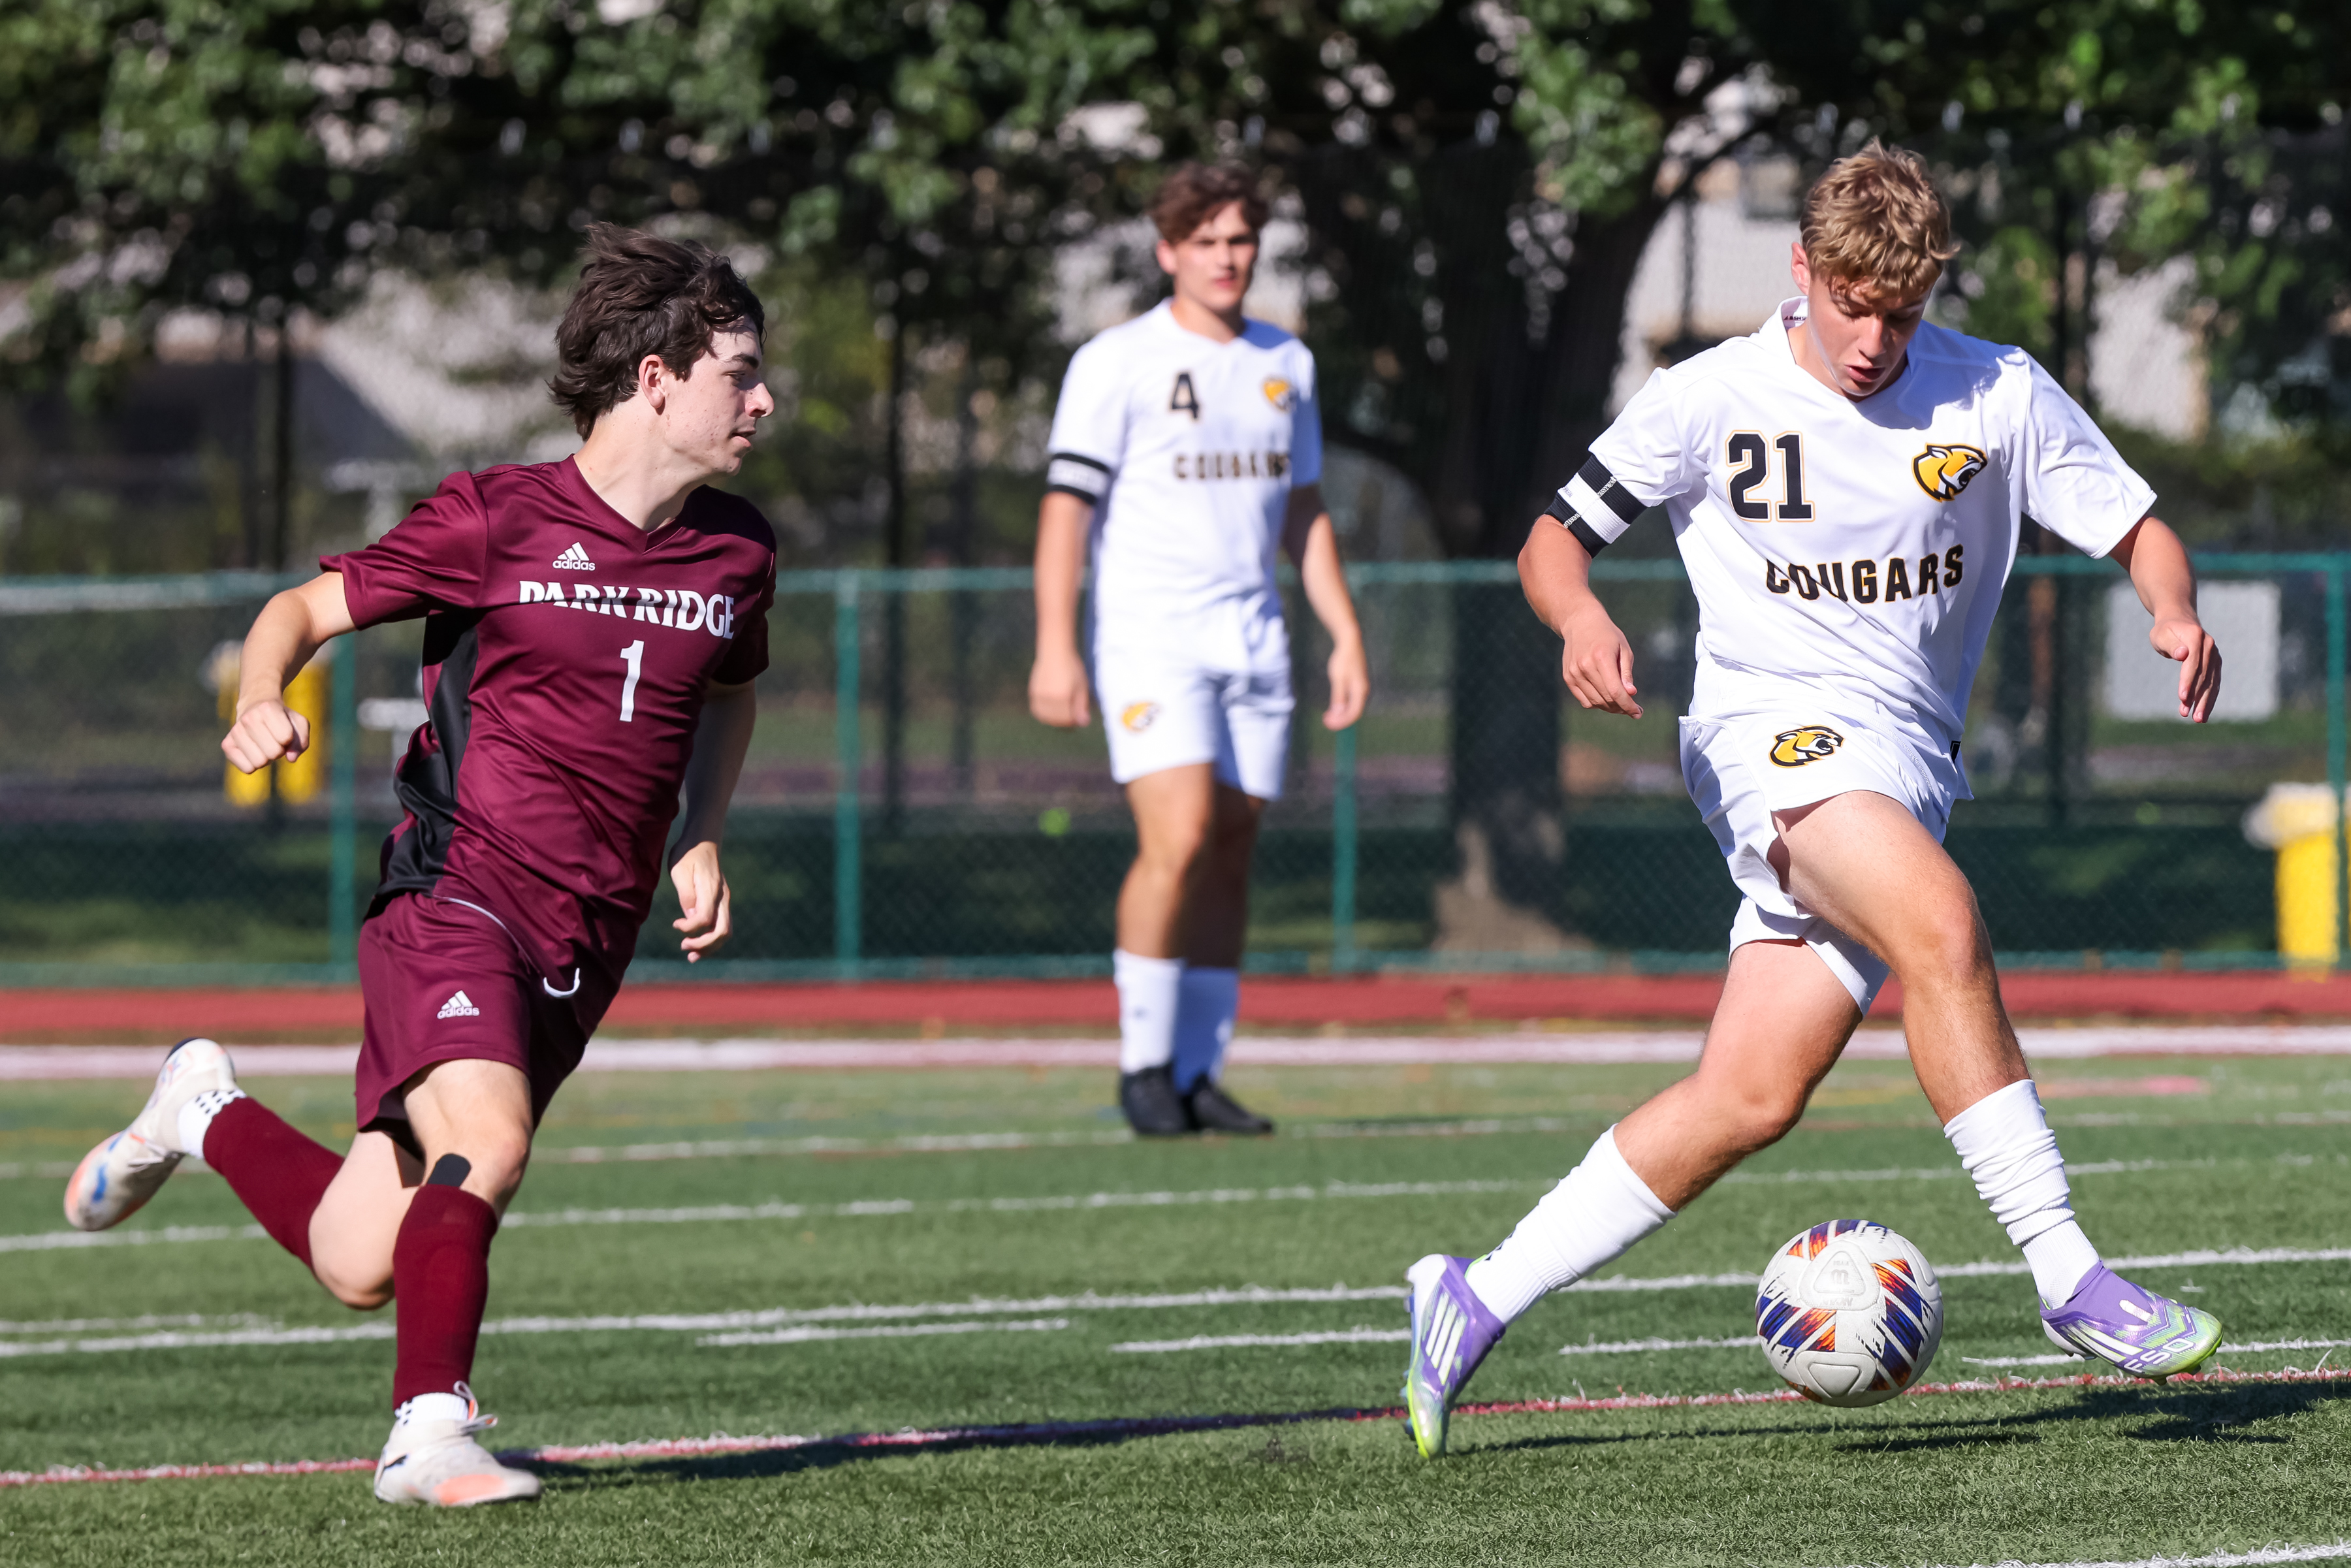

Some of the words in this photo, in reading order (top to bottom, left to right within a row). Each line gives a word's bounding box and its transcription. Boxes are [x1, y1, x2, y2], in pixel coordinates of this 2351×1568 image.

[1170, 372, 1200, 420] 4
[1725, 429, 1815, 523] 21
[552, 558, 596, 571] adidas
[1766, 543, 1964, 604] COUGARS
[633, 588, 734, 639] RIDGE
[620, 640, 645, 722] 1
[437, 1006, 480, 1019] adidas
[2124, 1337, 2195, 1373] F50
